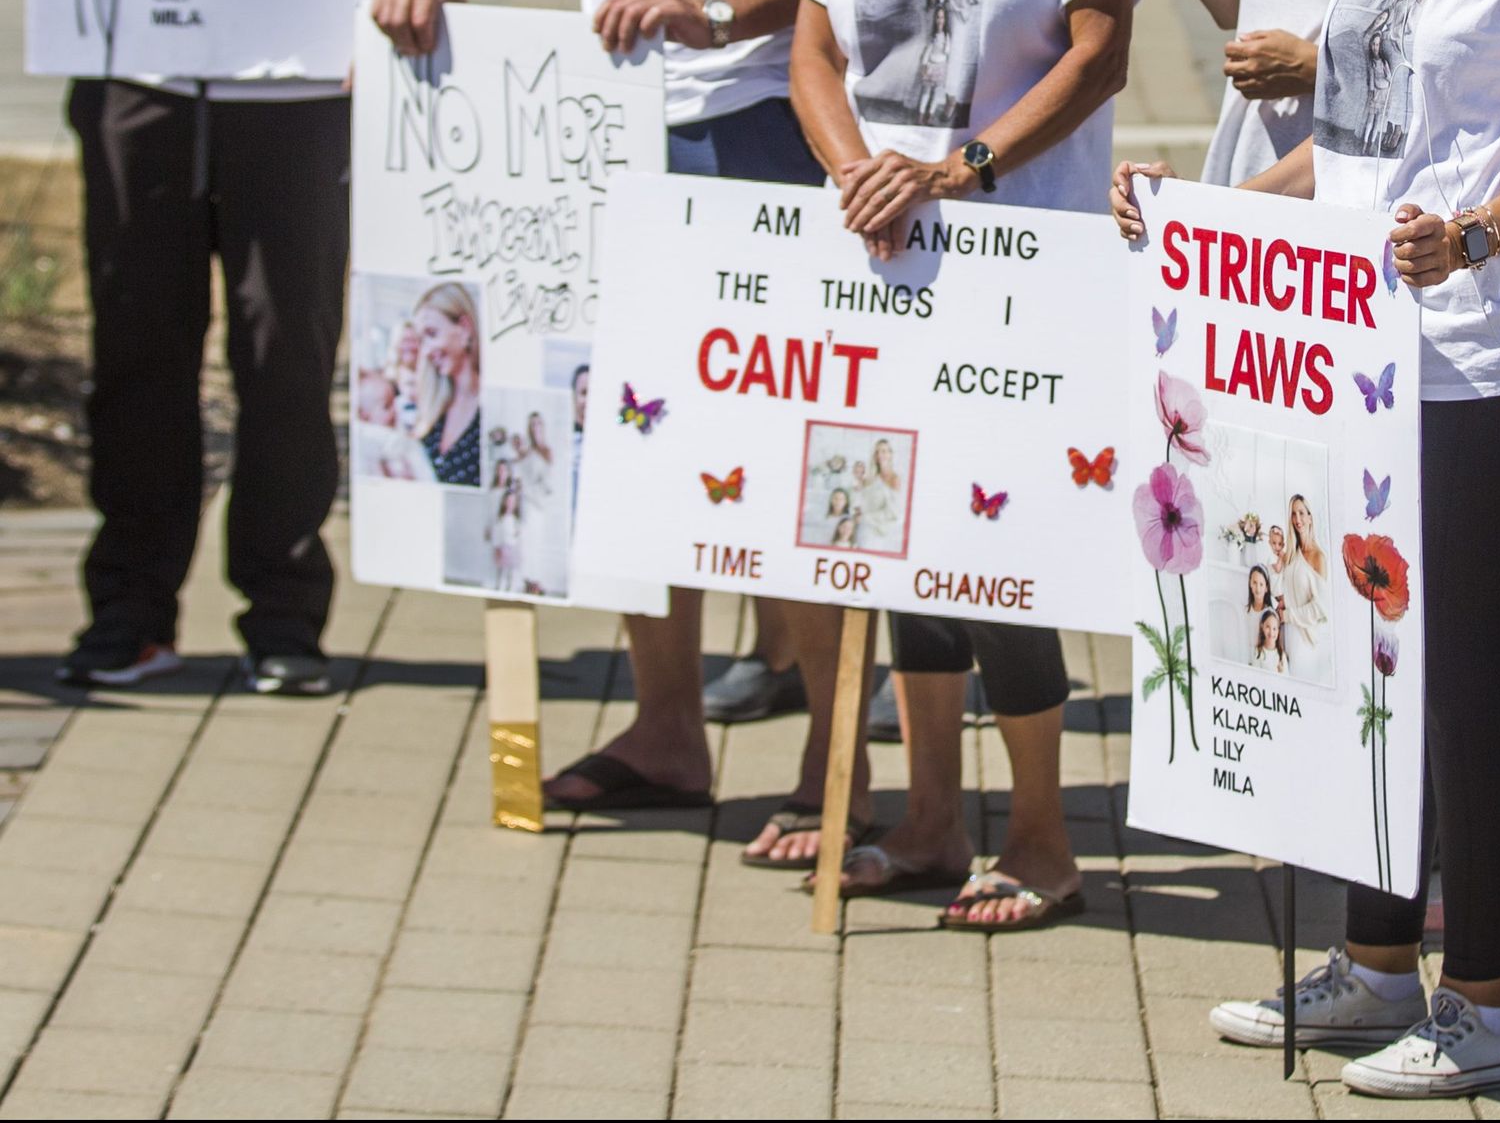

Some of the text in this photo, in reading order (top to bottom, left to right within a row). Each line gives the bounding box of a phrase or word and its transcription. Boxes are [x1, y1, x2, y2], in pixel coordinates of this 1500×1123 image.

[150, 7, 205, 27] MILA
[385, 48, 482, 174] NO
[686, 197, 693, 225] I
[753, 203, 801, 237] AM
[717, 271, 1012, 325] THE THINGS I
[1161, 220, 1378, 330] STRICTER
[697, 328, 1063, 408] CAN'T ACCEPT
[1204, 322, 1334, 416] LAWS
[693, 543, 1034, 610] TIME FOR CHANGE
[1211, 674, 1302, 718] KAROLINA
[1213, 705, 1272, 741] KLARA
[1213, 736, 1245, 763] LILY
[1213, 767, 1255, 797] MILA
